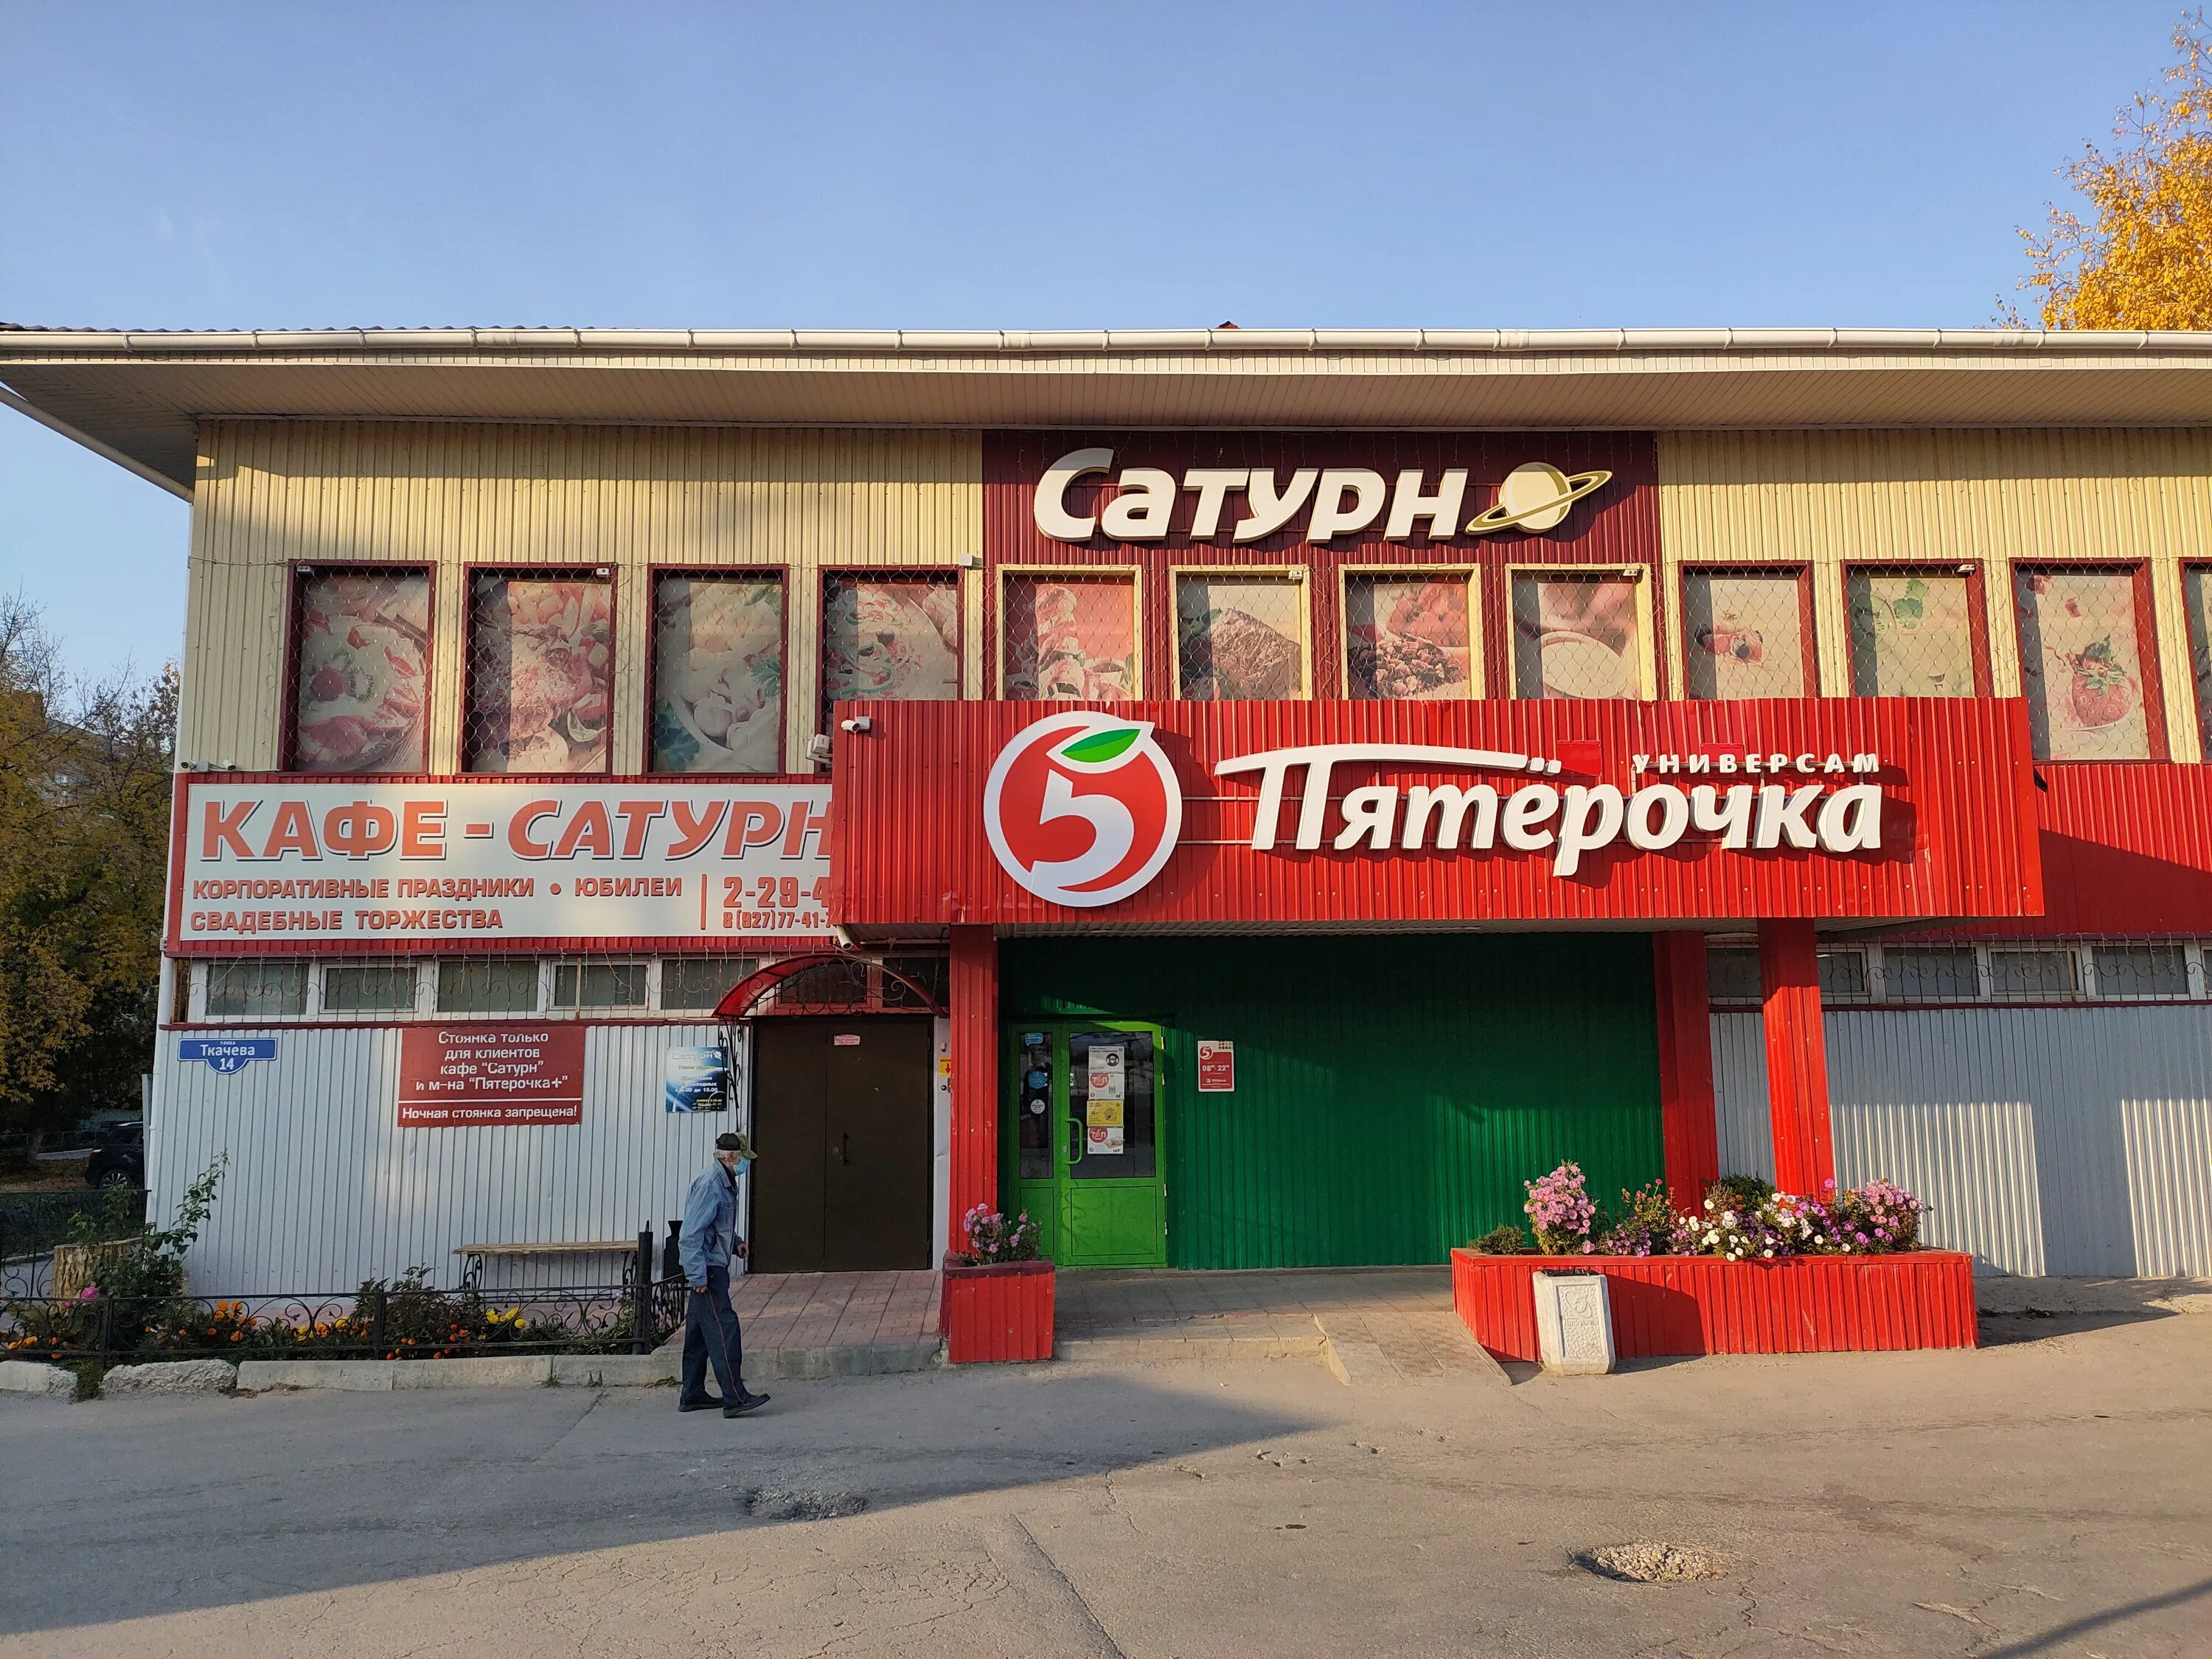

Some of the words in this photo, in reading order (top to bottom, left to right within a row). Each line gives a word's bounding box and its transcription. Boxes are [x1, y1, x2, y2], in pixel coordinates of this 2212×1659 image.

[1033, 447, 1469, 543] Сатурн
[1632, 753, 1880, 774] УНИВЕРСАМ
[201, 799, 450, 861] КАФЕ
[507, 799, 831, 861] САТУРН
[192, 878, 389, 900] КОРПОРАТИВНЫЕ
[397, 877, 535, 901] ПРАЗДНИКИ
[189, 910, 343, 935] СВАДЕБНЫЕ
[355, 909, 503, 931] ТОРЖЕСТВА
[438, 1032, 496, 1044] Стоянка
[501, 1032, 549, 1043] только
[200, 1044, 255, 1057] Ткачева
[445, 1049, 471, 1062] для
[475, 1048, 540, 1060] клиентов
[219, 1057, 234, 1070] 14
[440, 1062, 478, 1077] кафе
[416, 1082, 425, 1091] и
[428, 1080, 465, 1091] м-на
[403, 1107, 448, 1119] Ночная
[452, 1107, 501, 1118] стоянка
[505, 1105, 577, 1119] запрещена!
